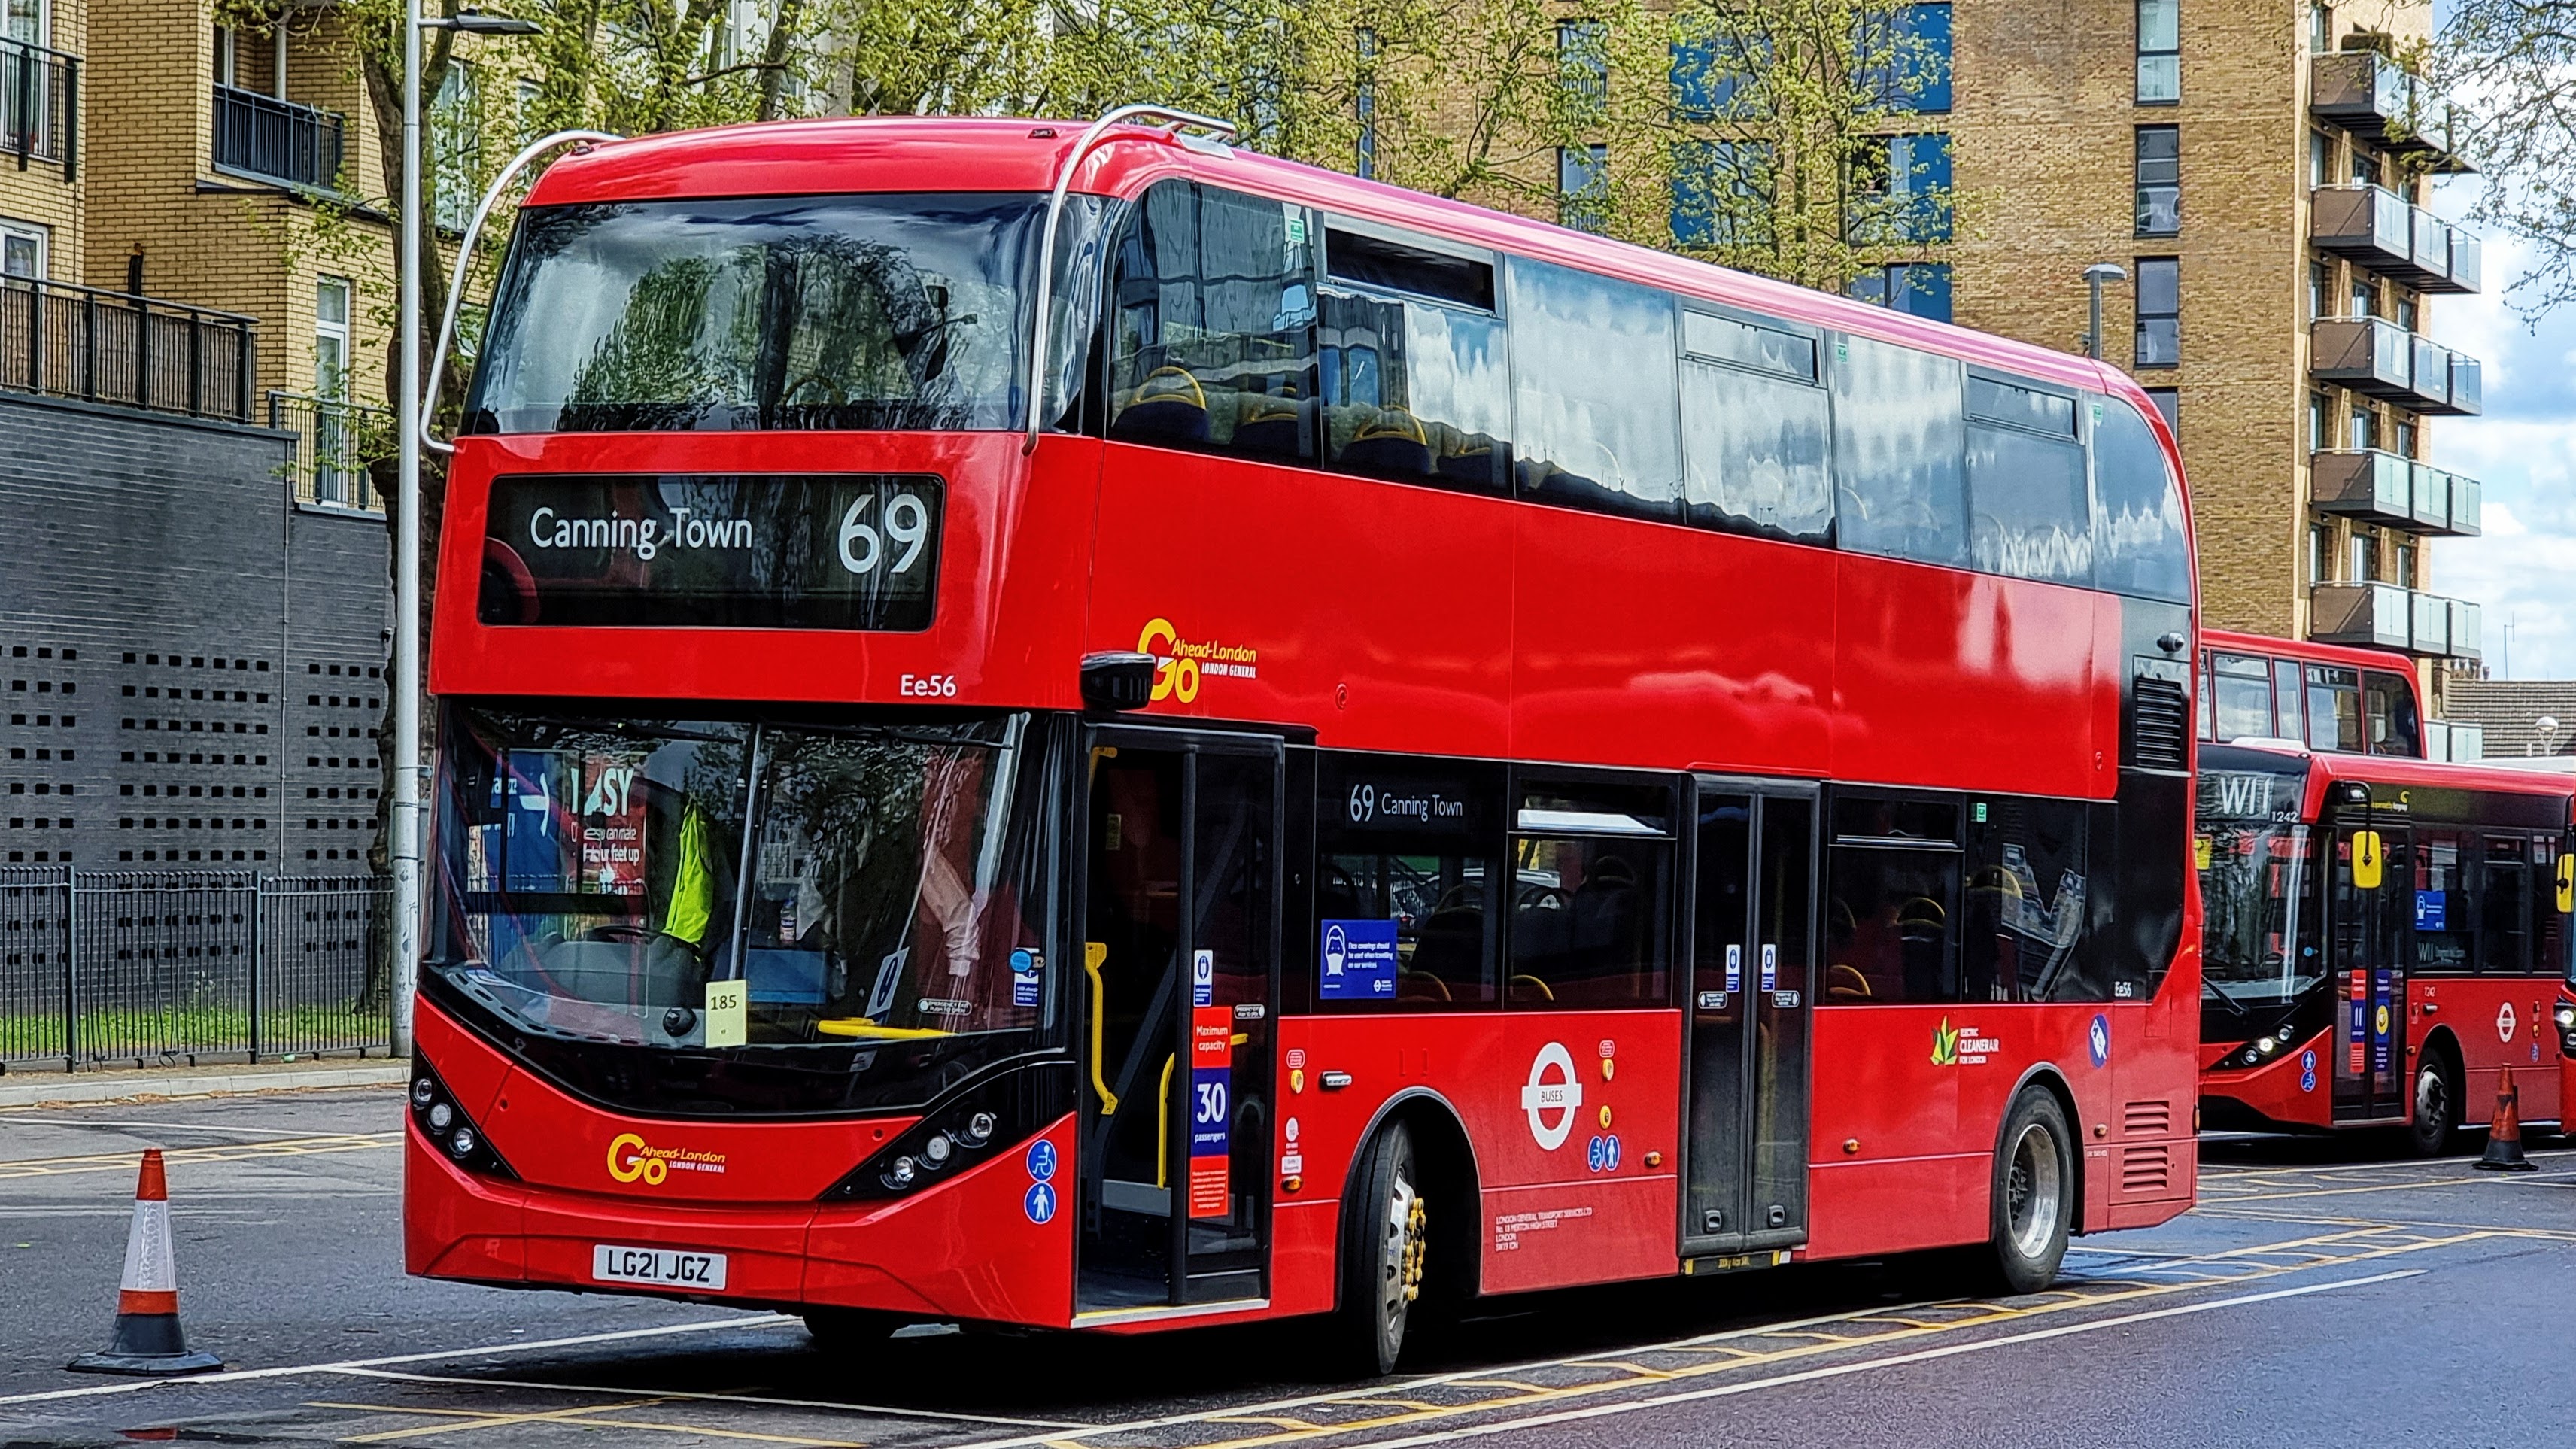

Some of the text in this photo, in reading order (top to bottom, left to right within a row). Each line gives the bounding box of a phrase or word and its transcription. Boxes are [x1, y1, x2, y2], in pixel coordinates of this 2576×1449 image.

[530, 506, 752, 560] Canning Town
[838, 494, 928, 575] 69
[1171, 639, 1256, 663] Ahead-London
[1201, 662, 1256, 679] LONDON GENERAL
[901, 674, 956, 697] Ee56
[1350, 784, 1463, 822] 69 Canning Town
[2271, 811, 2299, 823] 1242
[710, 994, 737, 1010] 185
[1196, 1025, 1228, 1036] Maximum
[1198, 1040, 1226, 1053] capacity
[1197, 1083, 1226, 1123] 30
[1541, 1090, 1563, 1103] BUSES
[1195, 1132, 1226, 1144] passengers
[607, 1133, 725, 1186] Go Ahead-London
[669, 1160, 724, 1174] LONDON GENERAL
[608, 1250, 711, 1282] LG21 JGZ
